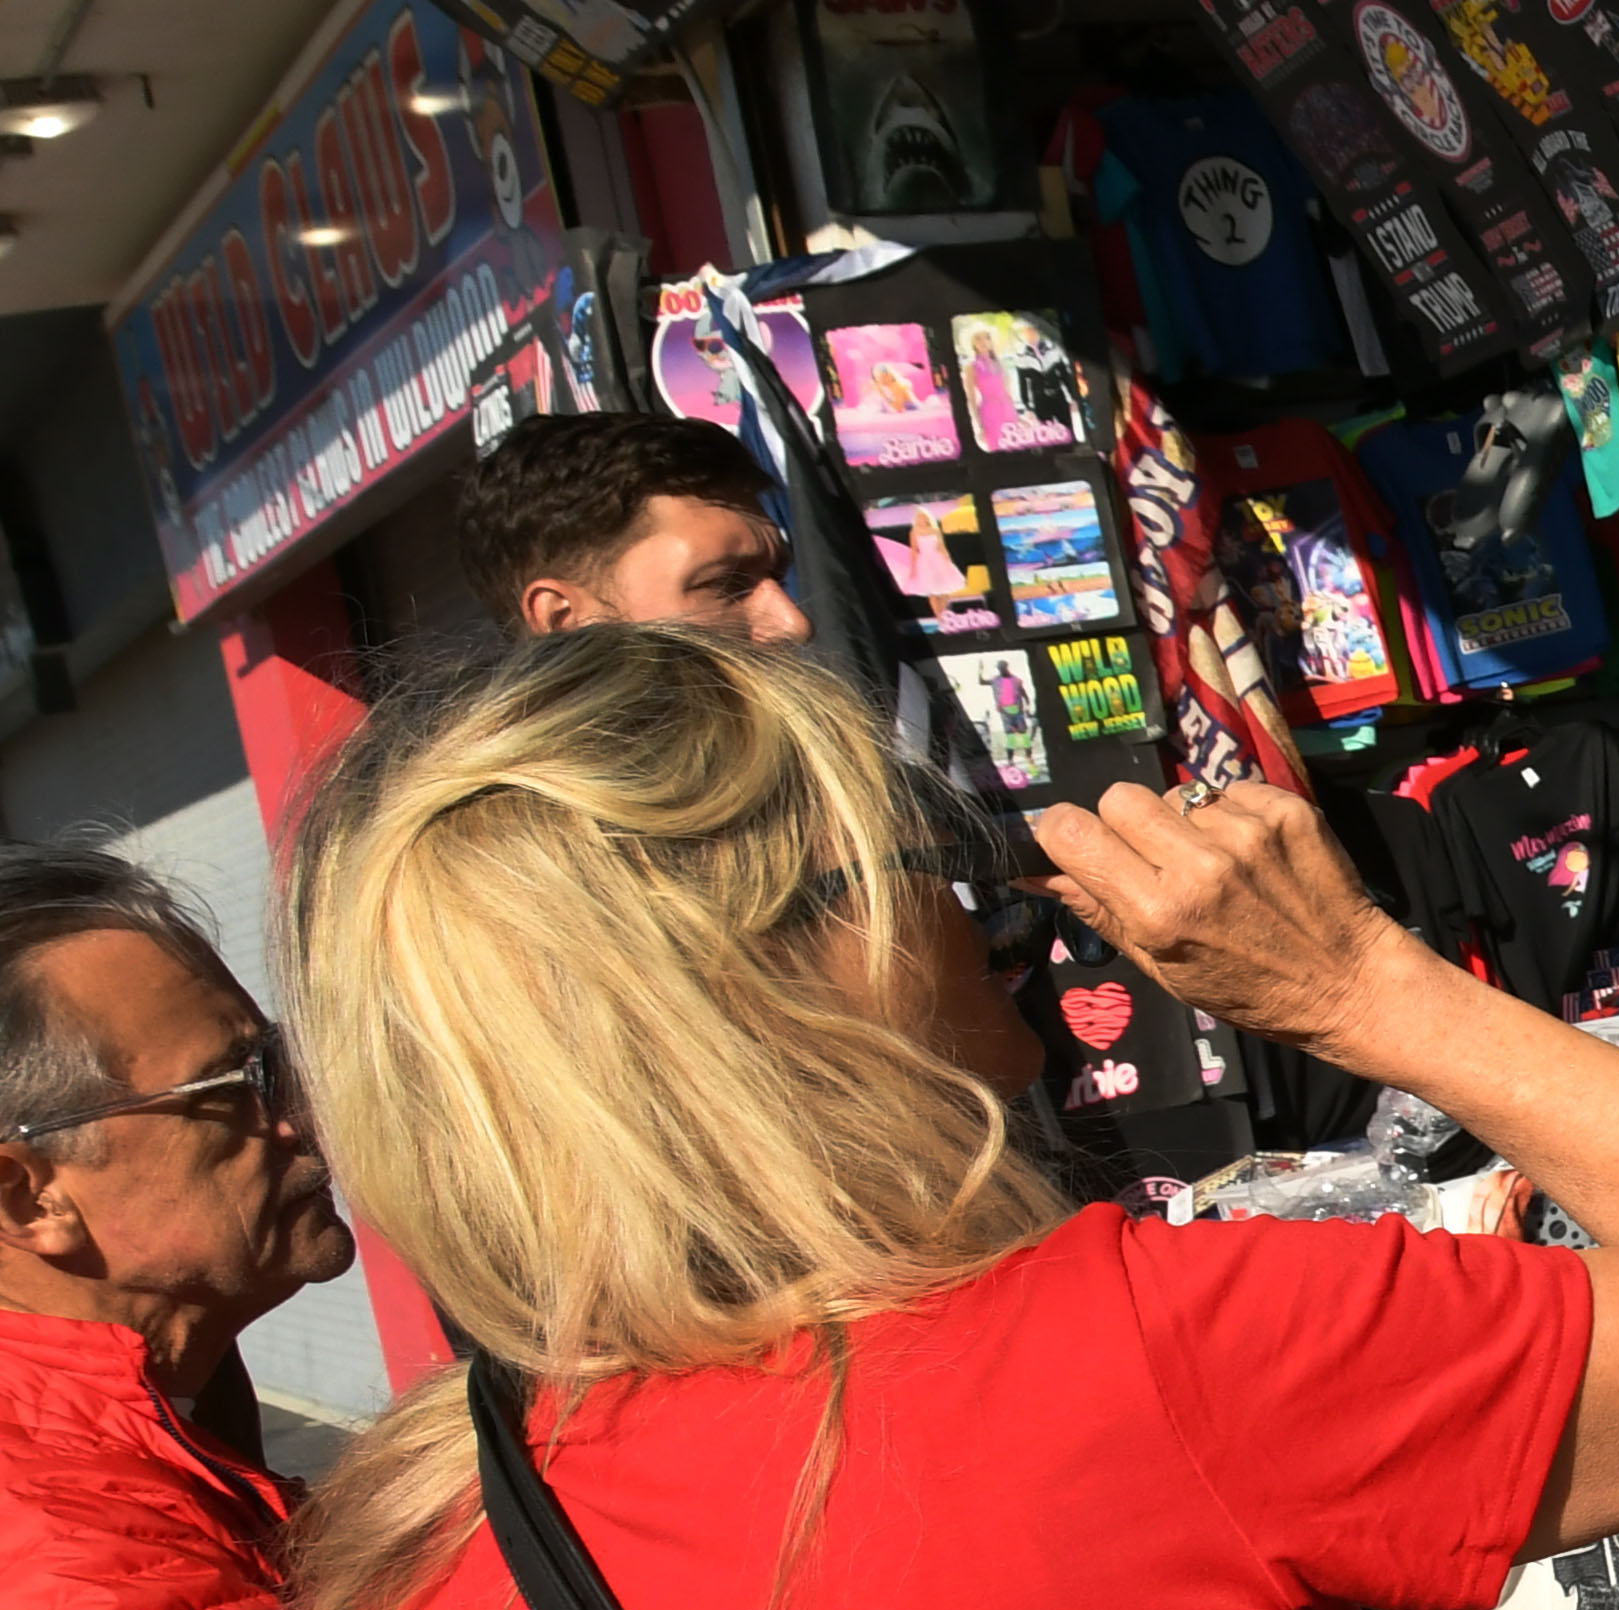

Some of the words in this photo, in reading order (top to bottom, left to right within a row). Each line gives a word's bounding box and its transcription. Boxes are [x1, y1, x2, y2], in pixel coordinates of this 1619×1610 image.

[1184, 167, 1264, 214] THING
[151, 228, 277, 471] WILD
[260, 7, 456, 369] CLAWS
[1223, 213, 1245, 245] 2
[1376, 203, 1440, 269] STAND
[1409, 272, 1482, 333] TRUMP
[347, 368, 390, 472] IN
[373, 263, 508, 452] WILDWOOD
[879, 434, 960, 467] Barbie
[997, 418, 1073, 449] Barbie
[1458, 598, 1562, 639] SONIC
[1047, 634, 1133, 684] WILD
[1058, 673, 1143, 725] WOOD
